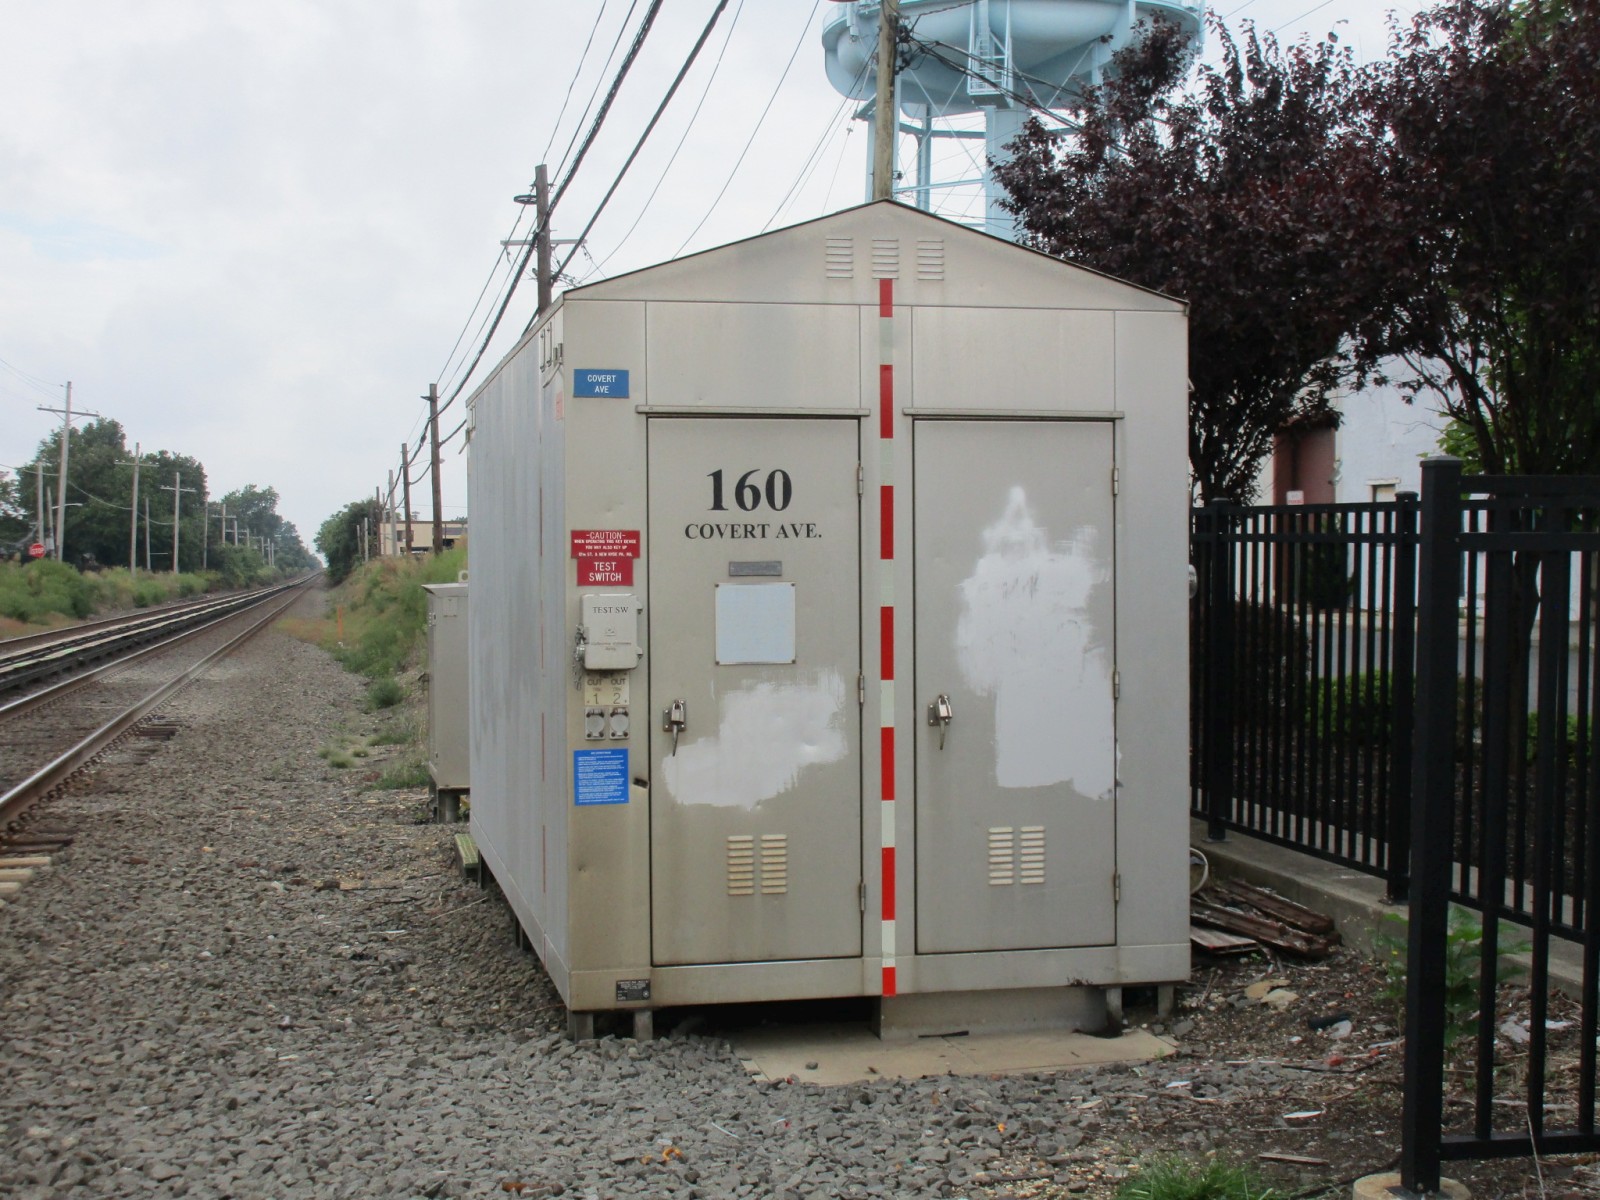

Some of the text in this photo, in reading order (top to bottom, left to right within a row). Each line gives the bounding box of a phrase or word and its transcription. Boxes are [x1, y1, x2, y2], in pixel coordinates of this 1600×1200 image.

[587, 374, 616, 382] COVERT
[594, 386, 610, 394] AVE
[706, 468, 793, 512] 160
[684, 522, 823, 540] COVERT AVE.
[594, 562, 616, 571] TEST
[589, 572, 622, 582] SWITCH
[593, 692, 620, 704] 1 2
